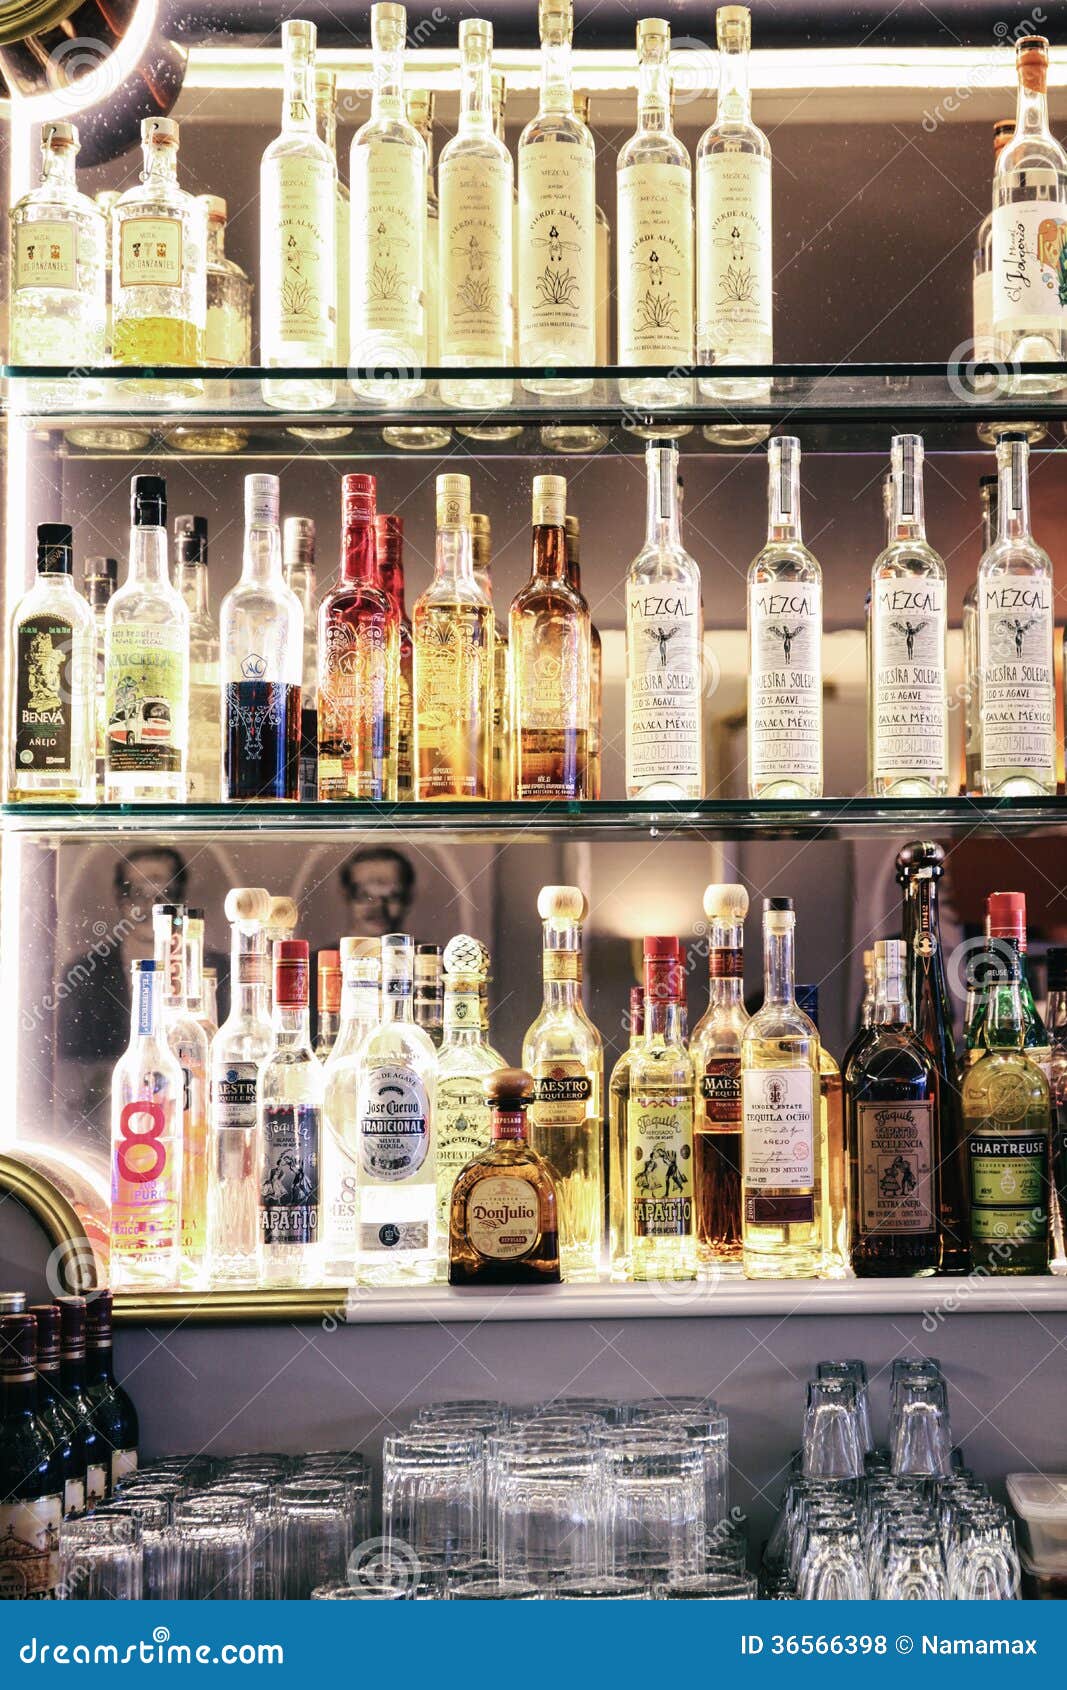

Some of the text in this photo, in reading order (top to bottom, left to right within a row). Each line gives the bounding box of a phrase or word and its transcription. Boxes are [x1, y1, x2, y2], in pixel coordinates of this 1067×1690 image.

[755, 594, 816, 616] MEZCAL
[879, 591, 942, 612] MEZCAL
[985, 588, 1049, 609] MEZCAL
[631, 597, 693, 618] MEZCAL
[985, 664, 1017, 683] NUESTRA
[775, 696, 800, 704] AGAVE
[898, 692, 922, 700] AGAVE
[1006, 689, 1030, 698] AGAVE
[652, 697, 677, 707] AGAVE
[29, 736, 57, 747] AÑEJO
[218, 1083, 257, 1095] AESTR
[532, 1079, 589, 1093] MAESTRO
[704, 1077, 742, 1091] MAES
[708, 1090, 742, 1098] TEQUIL
[366, 1100, 419, 1115] Jose Cuervo
[636, 1113, 682, 1135] Tequila
[747, 1113, 810, 1123] TEQUILA OCHO
[362, 1120, 422, 1133] TRADICIONAL
[115, 1100, 166, 1183] 8
[871, 1140, 924, 1149] EXCELENCIA
[969, 1142, 1044, 1154] CHARTREUSE
